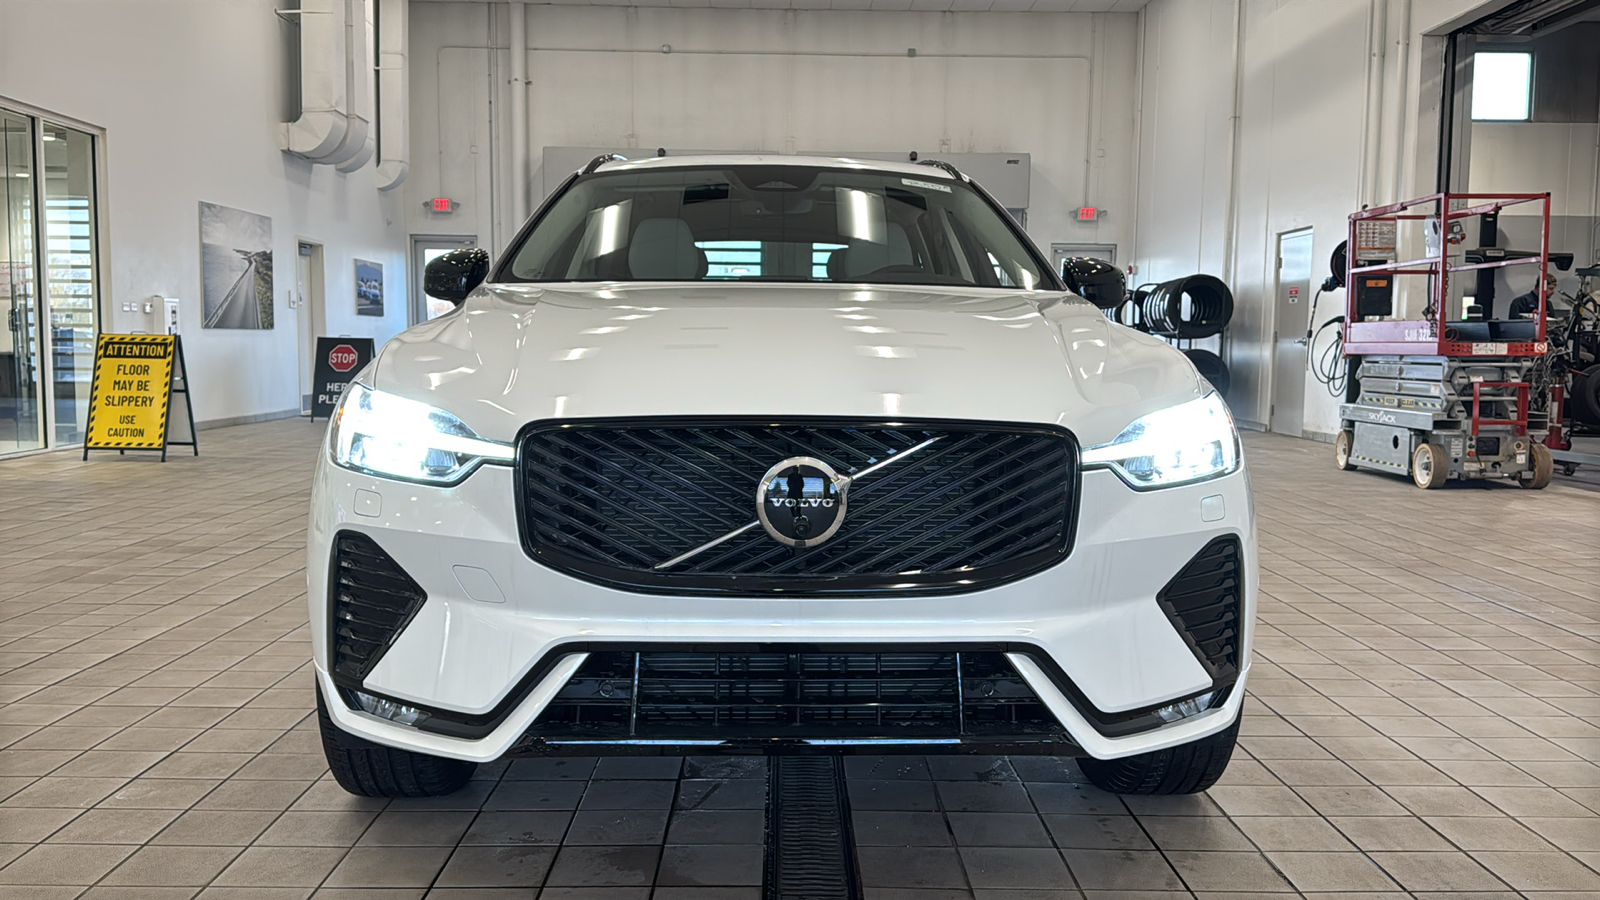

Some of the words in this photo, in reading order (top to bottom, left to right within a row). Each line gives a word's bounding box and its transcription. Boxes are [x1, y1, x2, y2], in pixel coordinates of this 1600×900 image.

[434, 198, 449, 210] EXIT
[1080, 207, 1095, 219] EXIT
[106, 344, 164, 356] ATTENTION
[331, 353, 356, 364] STOP
[117, 364, 150, 376] FLOOR
[112, 379, 134, 391] MAY
[136, 380, 150, 391] BE
[326, 382, 348, 392] HER
[104, 395, 155, 407] SLIPPERY
[318, 394, 340, 404] PLE
[119, 415, 136, 425] USE
[1368, 411, 1396, 423] SKYJACK
[107, 428, 145, 438] CAUTION
[770, 498, 835, 508] VOLVO
